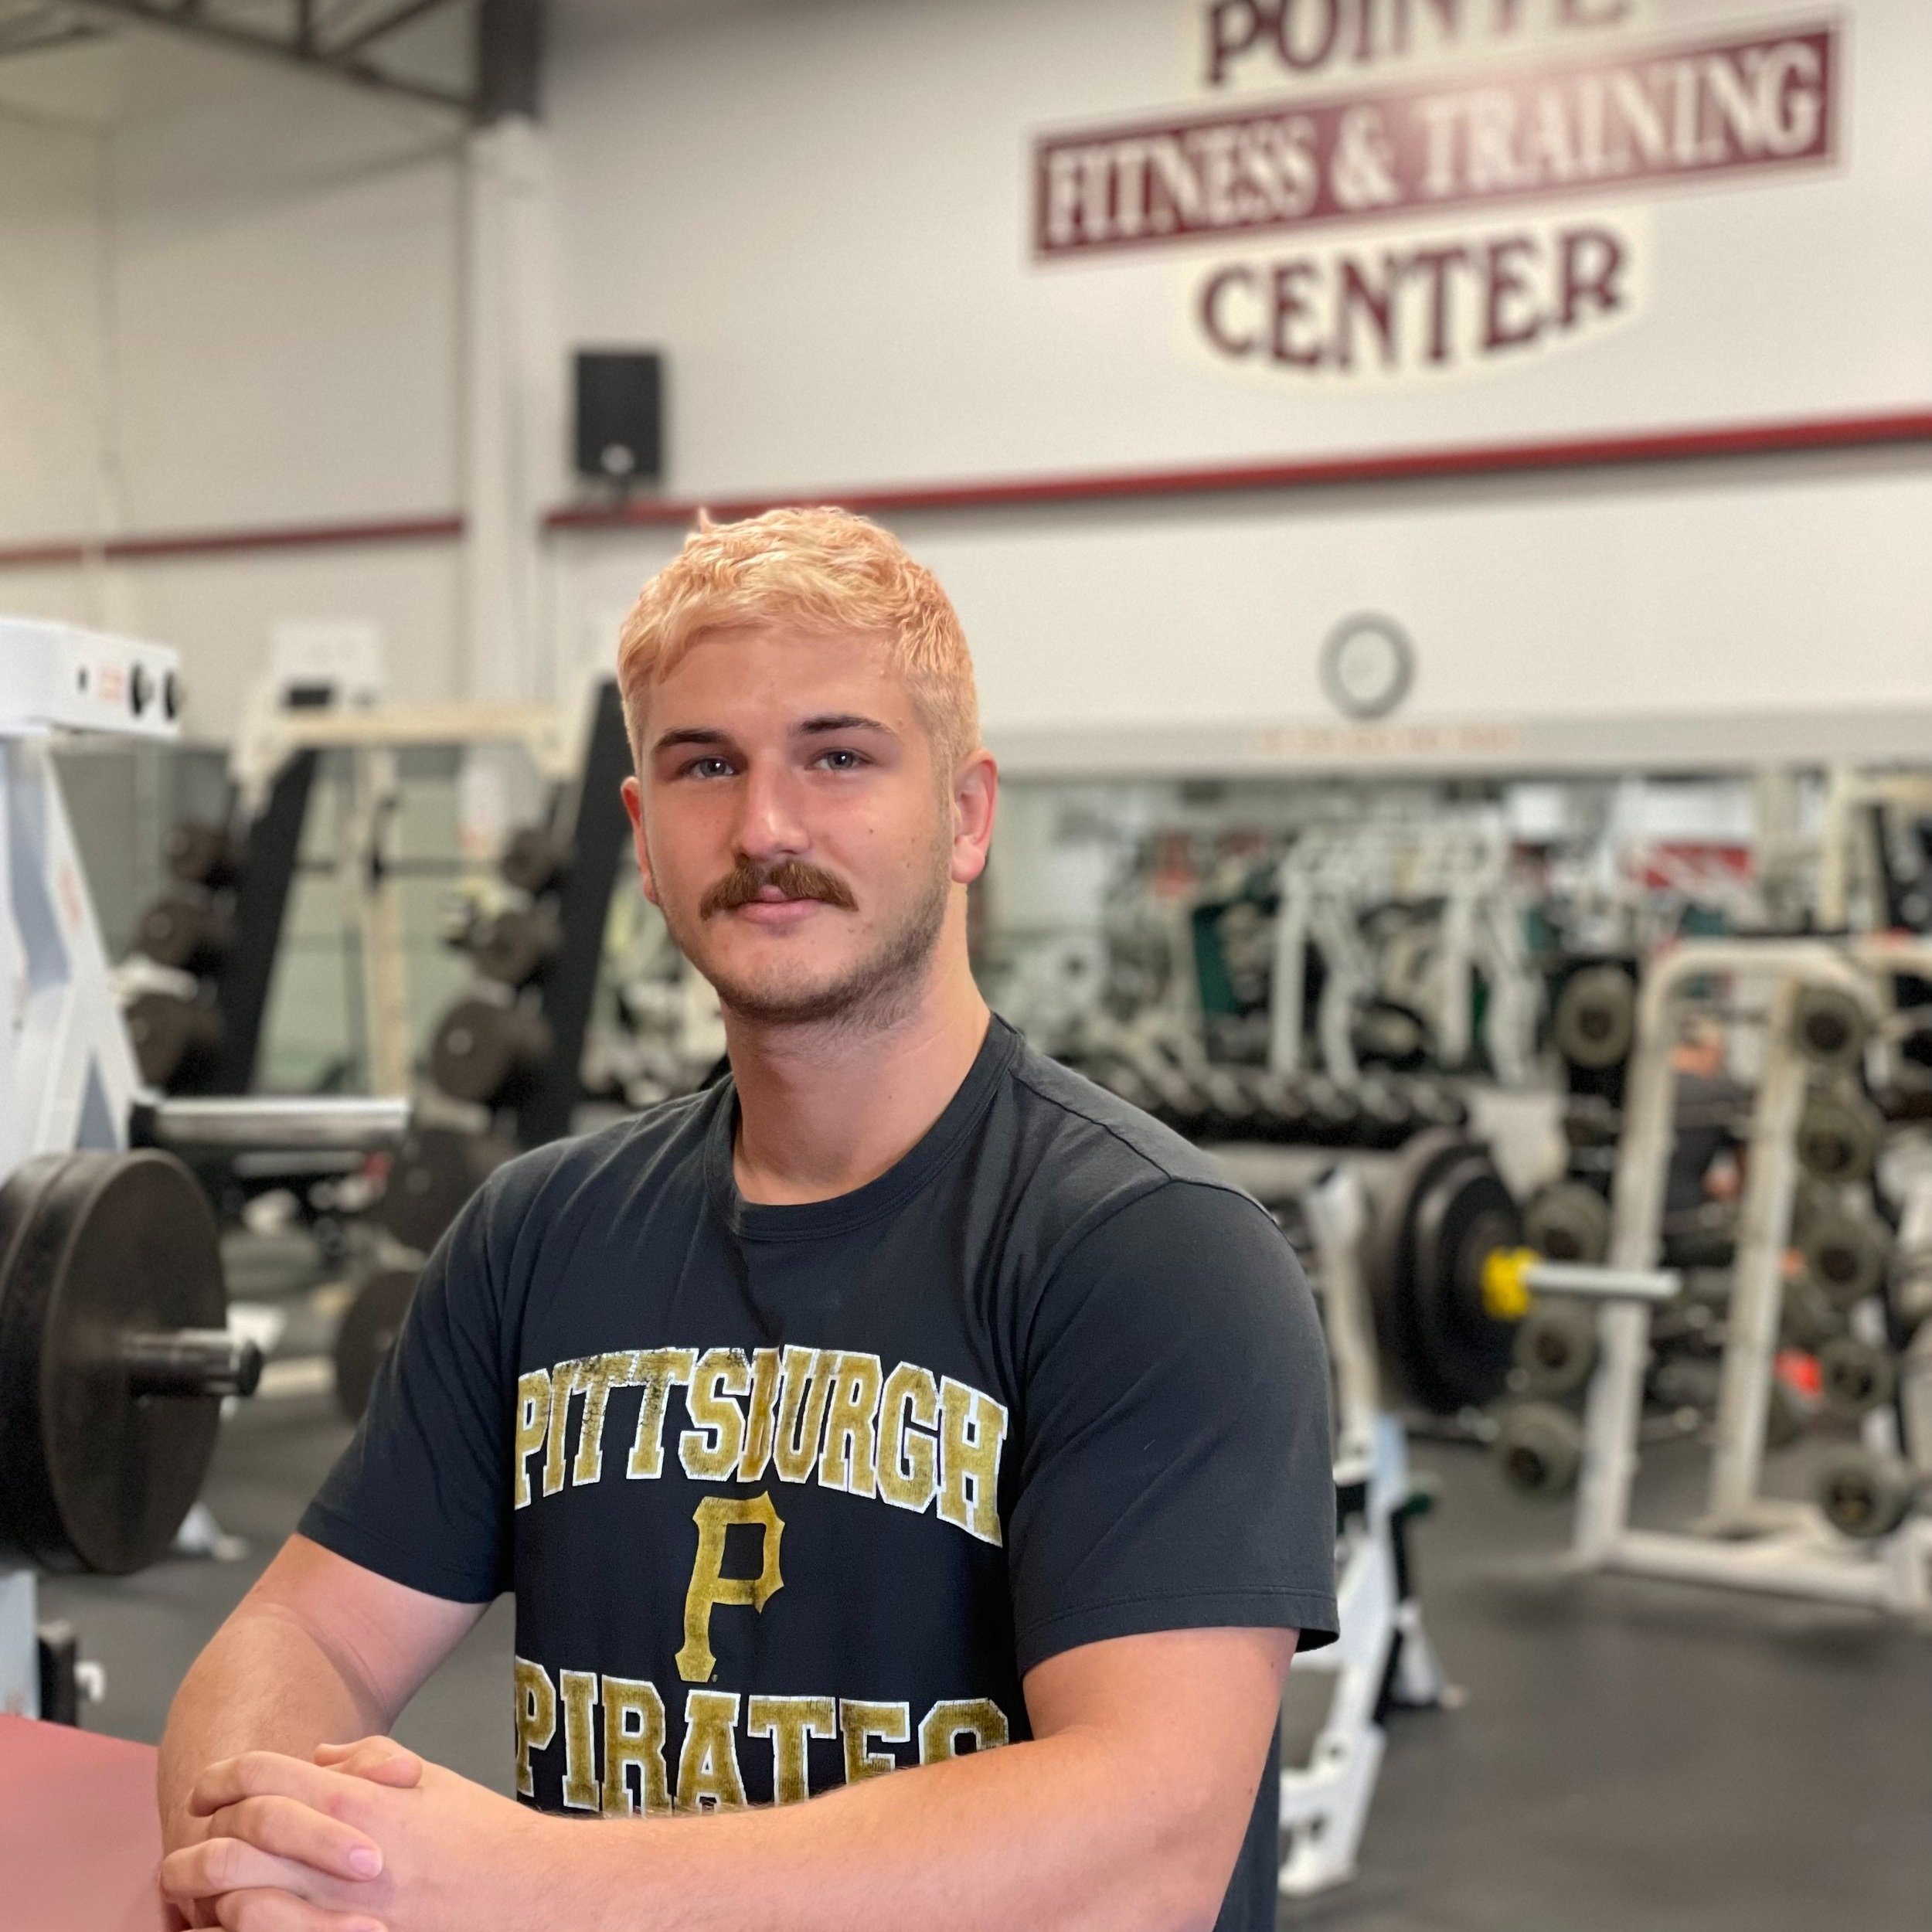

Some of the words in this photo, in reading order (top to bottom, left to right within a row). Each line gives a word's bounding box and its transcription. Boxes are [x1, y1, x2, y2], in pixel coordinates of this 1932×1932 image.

[1049, 114, 1316, 243] FITNESS
[1331, 103, 1403, 209] &
[1413, 40, 1821, 196] TRAINING
[1198, 228, 1626, 372] CENTER
[515, 1345, 1009, 1547] PITTSBURGH
[675, 1491, 785, 1682] P
